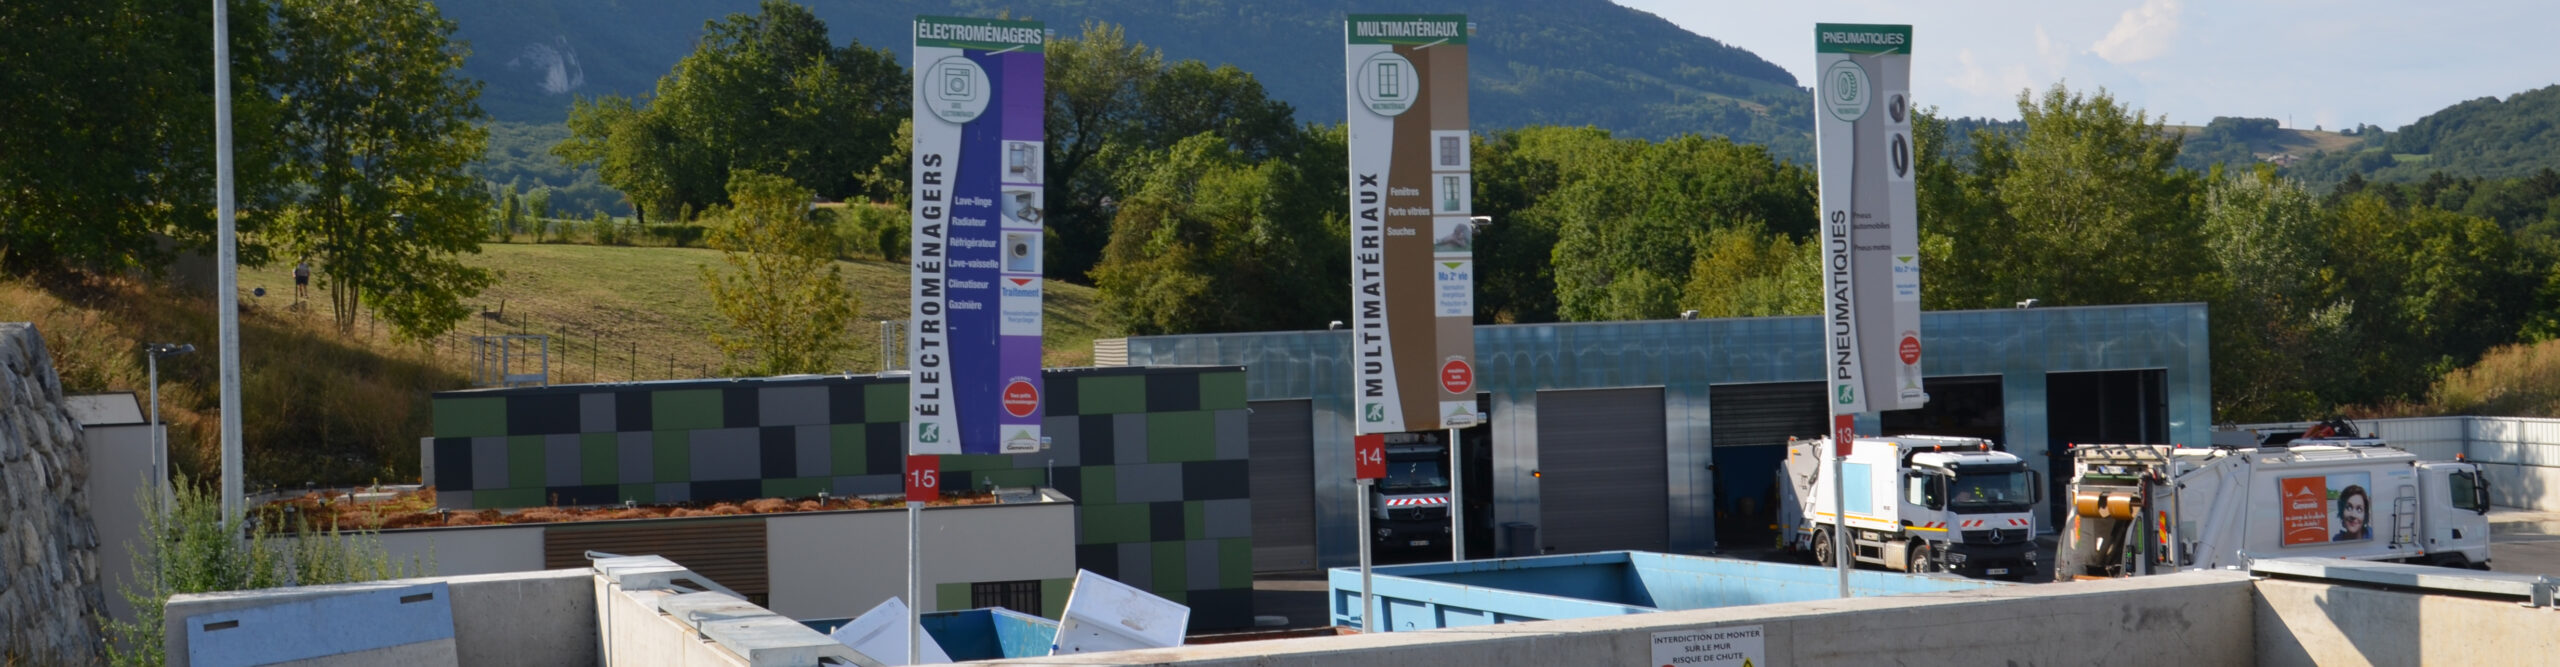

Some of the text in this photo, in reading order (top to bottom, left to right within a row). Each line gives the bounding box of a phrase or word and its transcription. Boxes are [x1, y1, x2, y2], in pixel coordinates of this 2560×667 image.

[918, 19, 1042, 45] ÉLECTROMÉNAGERS
[1356, 18, 1459, 37] MULTIMATÉRIAUX
[1822, 31, 1905, 45] PNEUMATIQUES
[1390, 187, 1420, 196] Fenêtres
[954, 196, 993, 208] Lave-linge
[1388, 207, 1407, 216] Porte
[951, 217, 987, 227] Radiateur
[1387, 227, 1416, 237] Souches
[949, 237, 997, 249] Réfrigérateur
[948, 258, 999, 269] Lave-vaisselle
[915, 153, 942, 416] ÉLECTROMÉNAGERS
[948, 279, 990, 290] Climatiseur
[1357, 173, 1383, 397] MULTIMATÉRIAUX
[1002, 287, 1040, 297] Traitement
[1832, 210, 1852, 380] PNEUMATIQUES
[948, 299, 983, 311] Gazinière
[1838, 426, 1853, 445] 13
[1359, 447, 1382, 467] 14
[911, 469, 936, 489] 15
[1654, 630, 1761, 645] INTERDICTION DE MONTER
[1684, 645, 1701, 653] SUR
[1702, 644, 1711, 652] LE
[1672, 652, 1744, 664] RISQUE DE CHUTE
